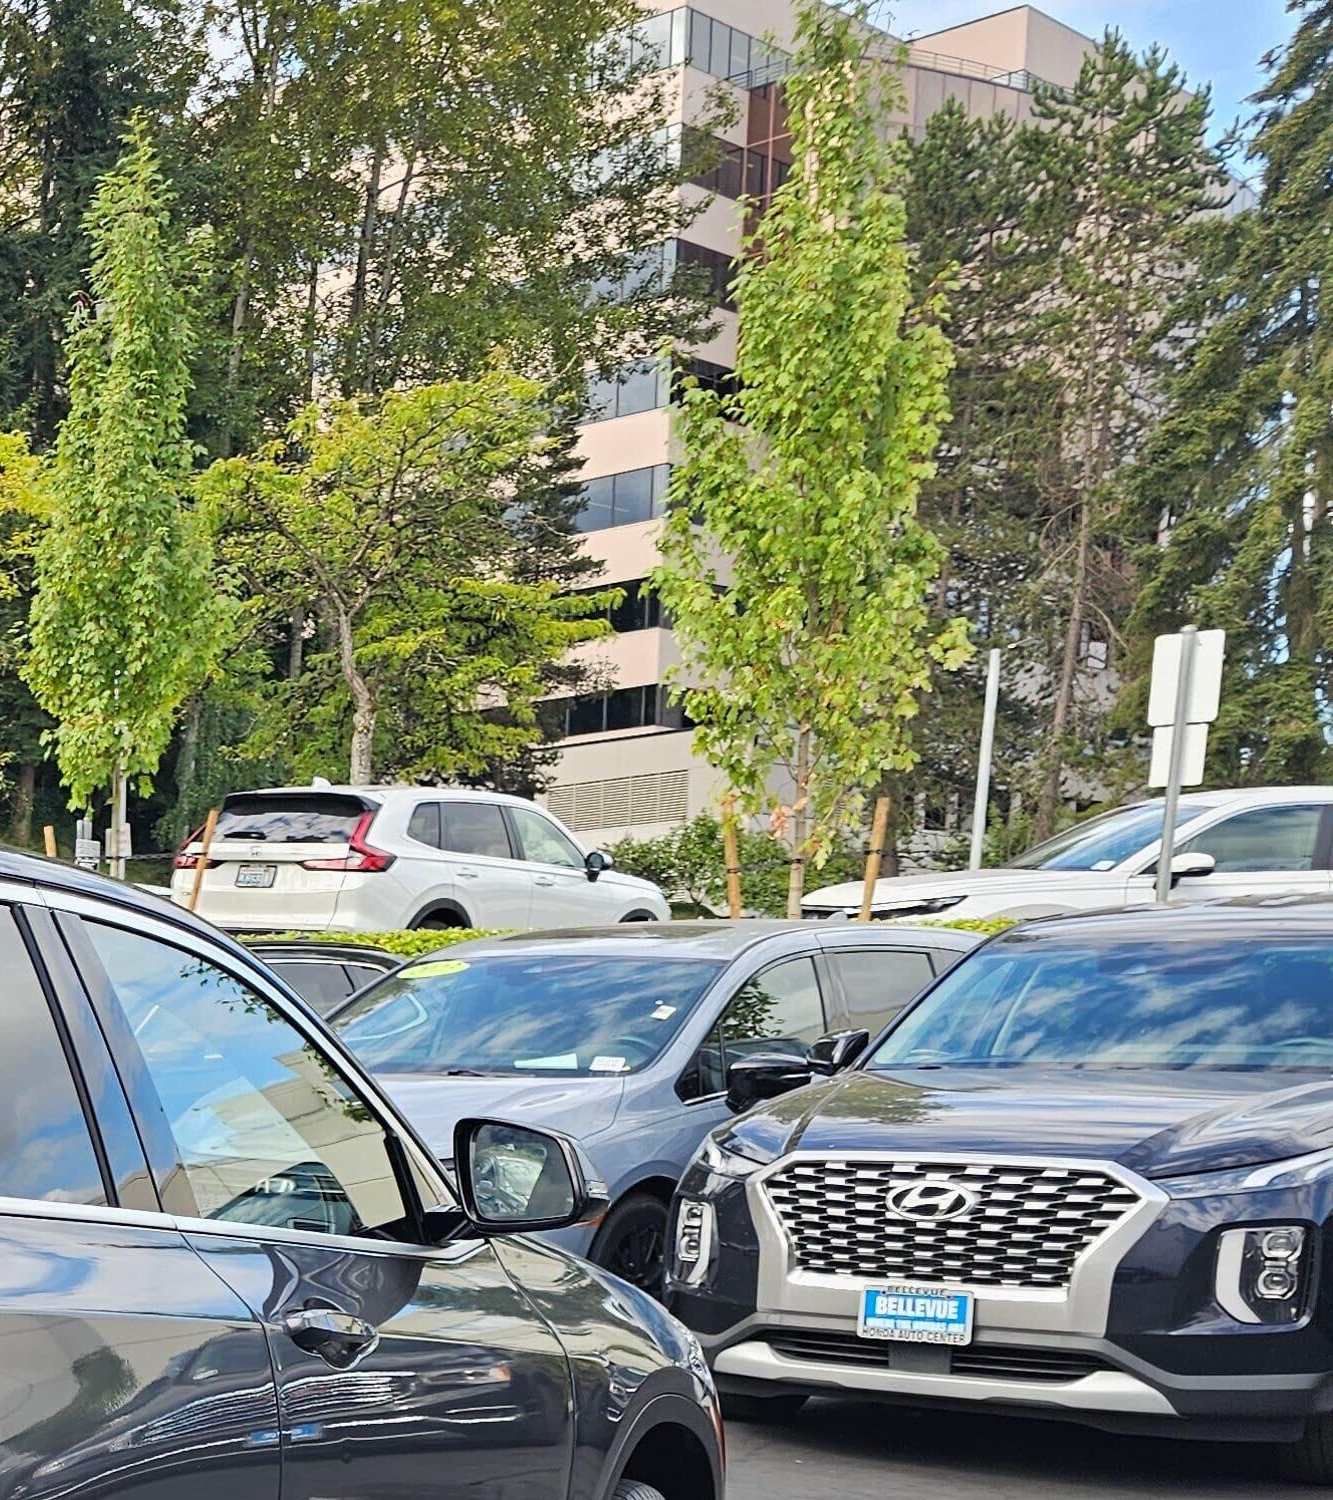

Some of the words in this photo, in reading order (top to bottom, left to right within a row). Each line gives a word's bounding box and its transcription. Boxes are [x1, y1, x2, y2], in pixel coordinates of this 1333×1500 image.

[875, 1296, 959, 1319] BELLEVUE
[898, 1328, 924, 1339] AUTO
[927, 1331, 965, 1343] CENTER
